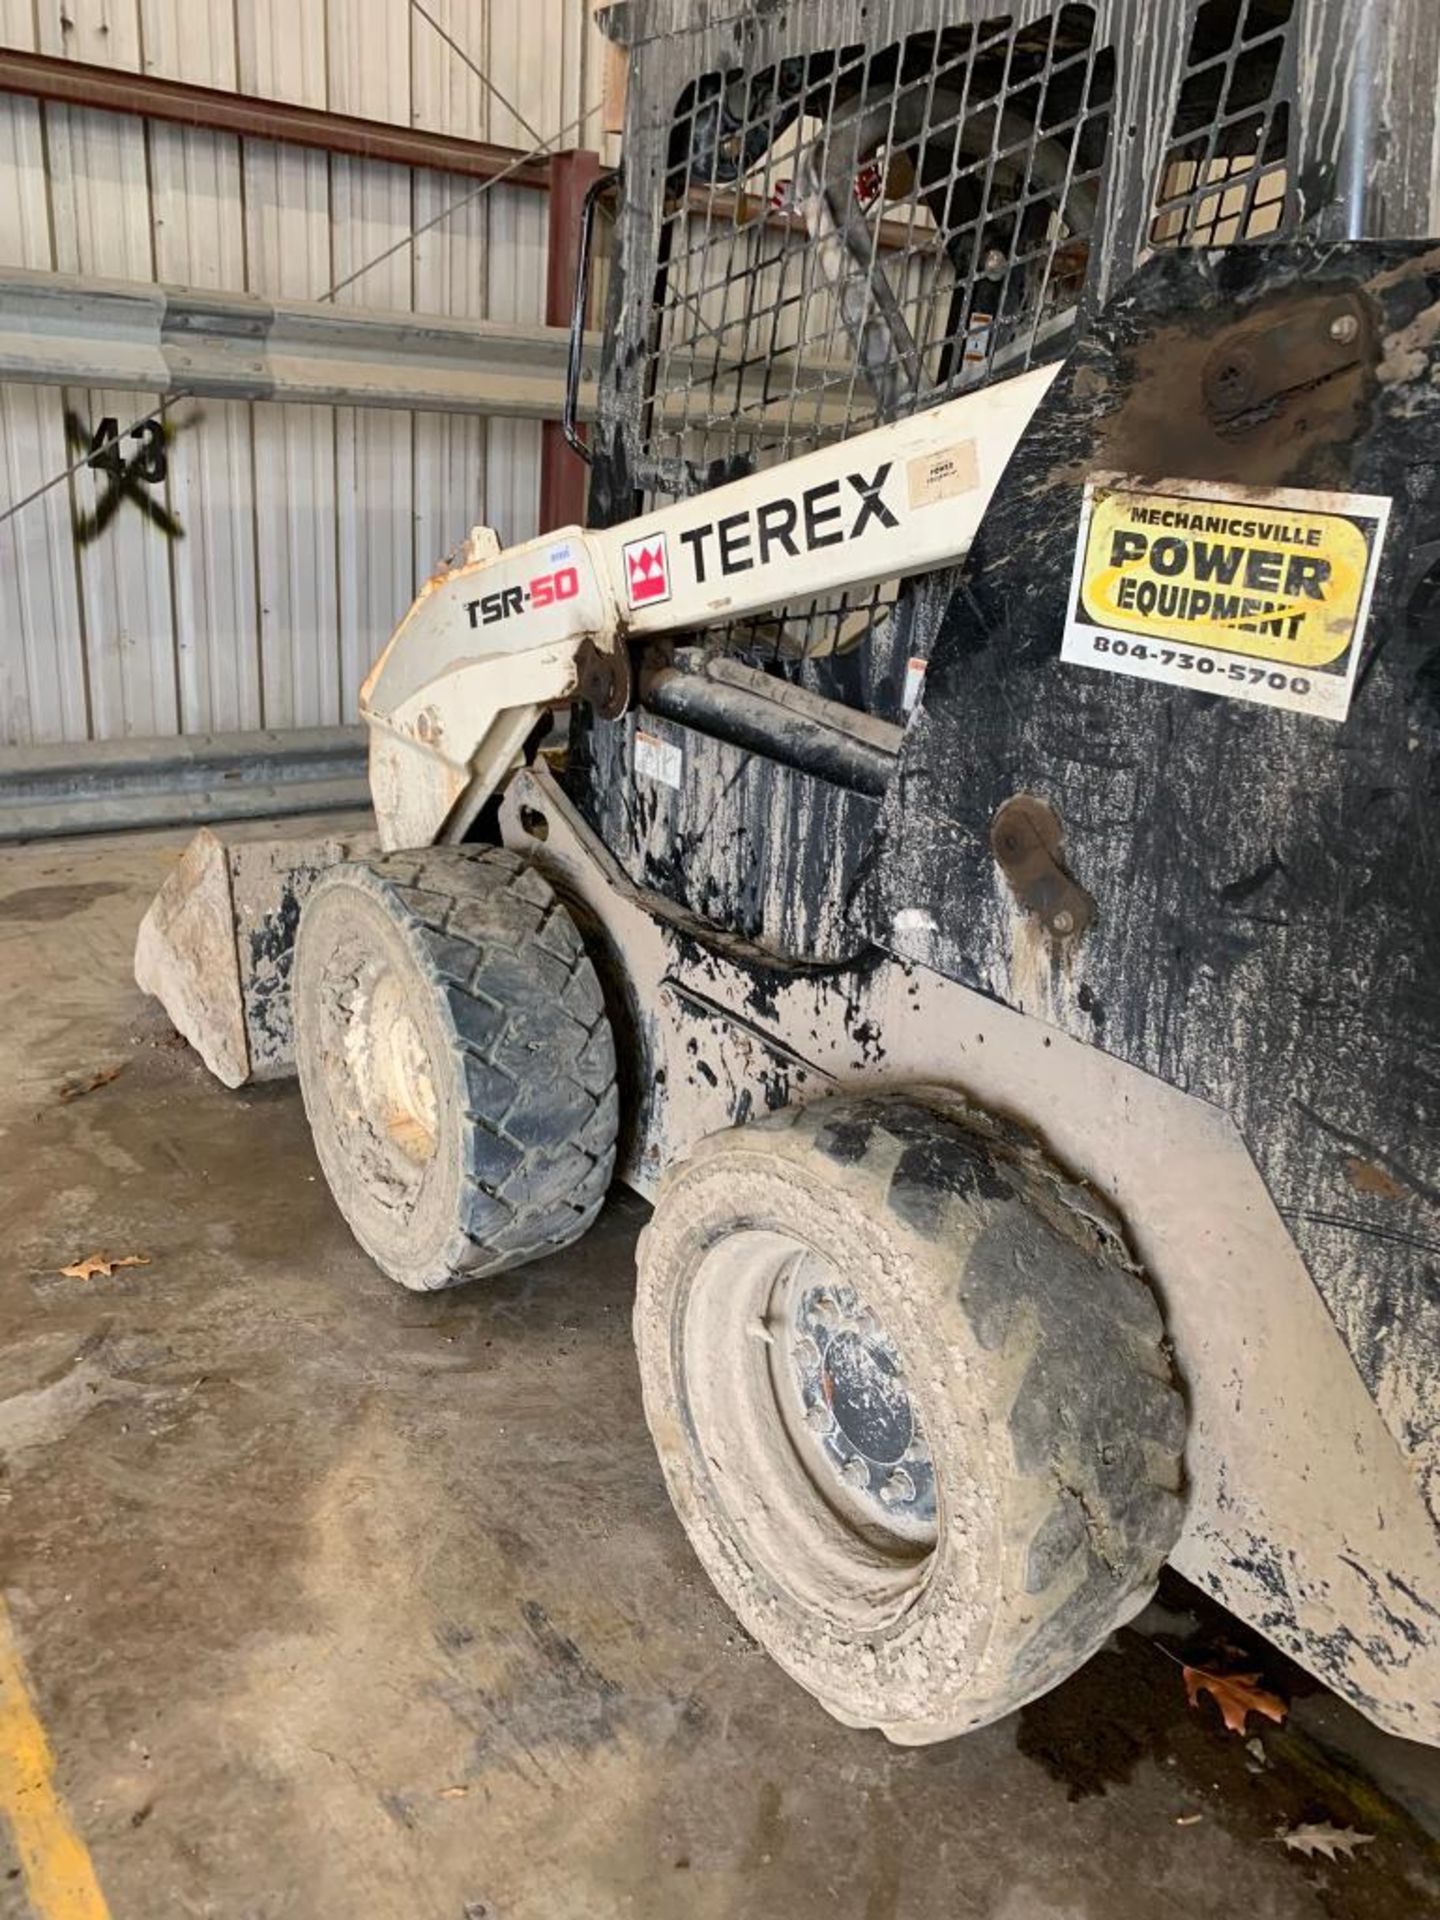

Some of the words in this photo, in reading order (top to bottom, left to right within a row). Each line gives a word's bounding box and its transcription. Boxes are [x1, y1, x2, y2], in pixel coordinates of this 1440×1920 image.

[680, 462, 900, 584] TEREX
[1130, 507, 1322, 547] MECHANICSVILLE
[1109, 529, 1332, 602] POWER
[464, 567, 580, 629] TSR-50
[1117, 577, 1306, 641] EQUIPMENT
[1092, 636, 1312, 696] 804-730-5700
